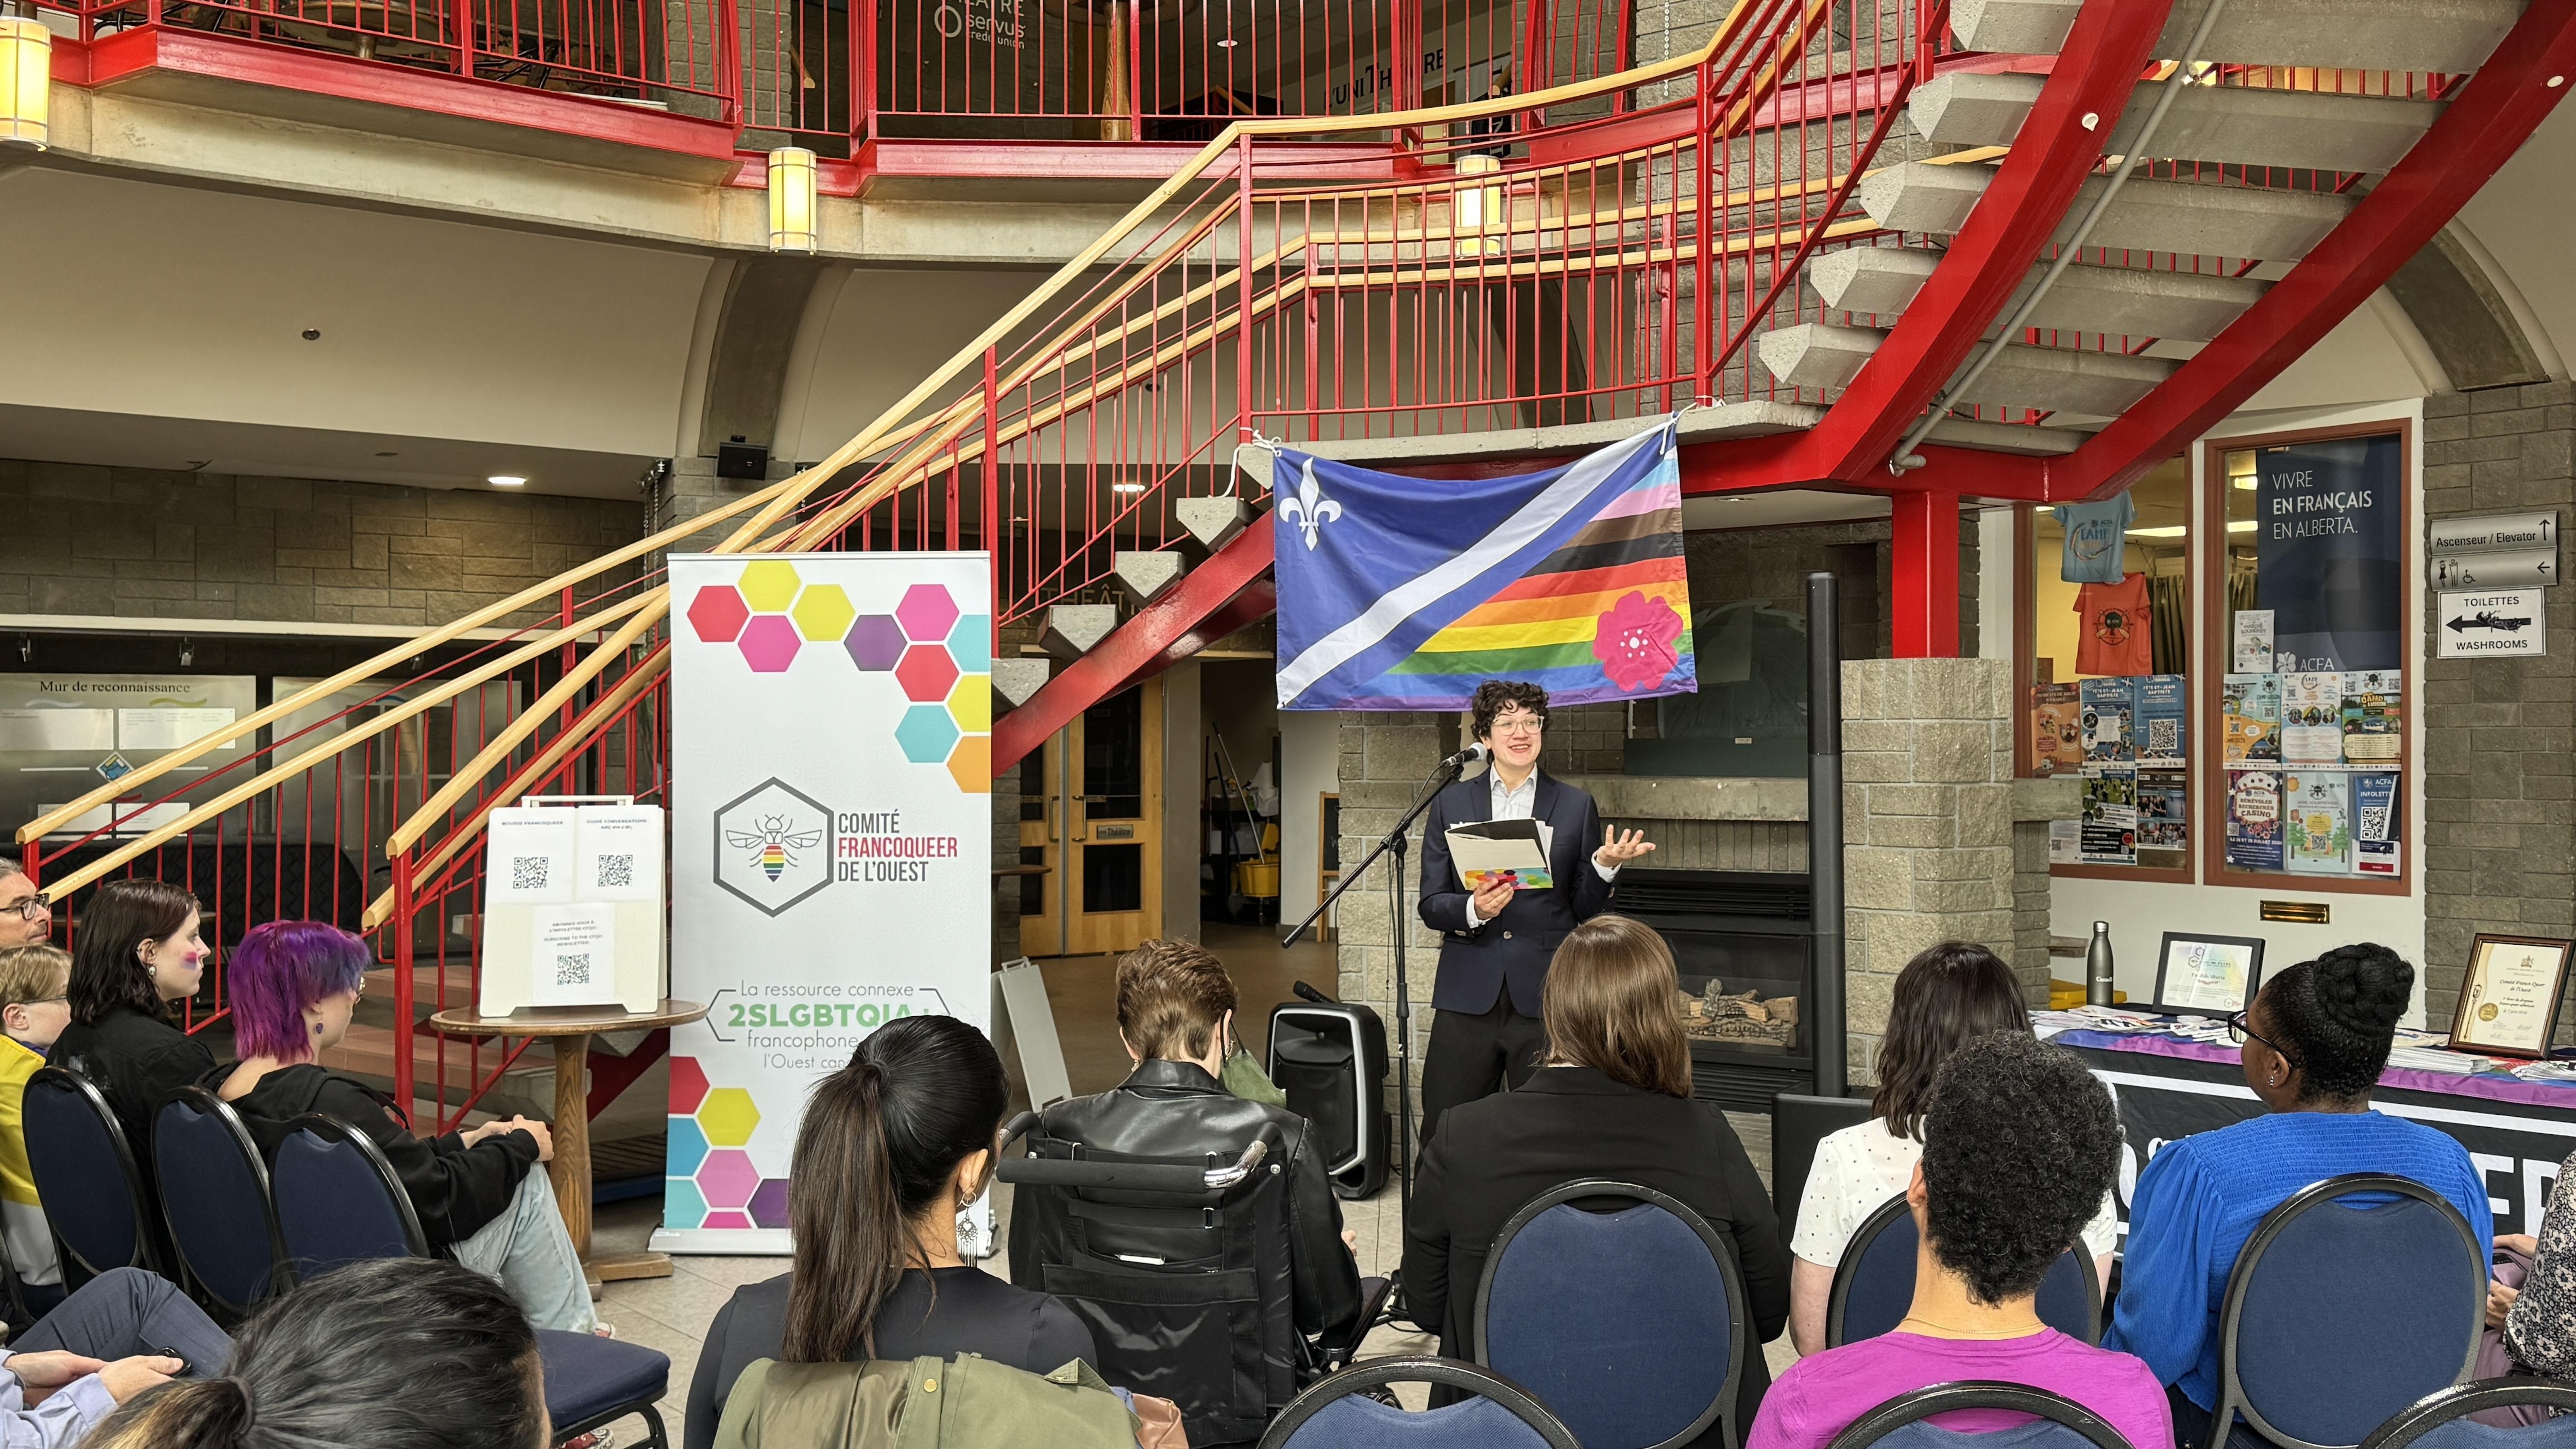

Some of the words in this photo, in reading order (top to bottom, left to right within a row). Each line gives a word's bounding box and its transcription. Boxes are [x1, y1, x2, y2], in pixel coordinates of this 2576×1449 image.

[2272, 470, 2313, 490] VIVRE
[2273, 497, 2293, 515] EN
[2297, 490, 2372, 513] FRANÇAIS
[2274, 522, 2292, 539] EN
[2296, 517, 2358, 537] ALBERTA.
[2436, 535, 2487, 548] Ascenseur
[2489, 533, 2493, 544] /
[2497, 532, 2536, 543] Elevator
[2464, 596, 2519, 607] TOILETTES
[2456, 640, 2528, 650] WASHROOMS
[2300, 657, 2335, 672] ACFA
[40, 680, 68, 692] Mur
[73, 680, 88, 692] de
[92, 681, 191, 693] reconnaissance
[838, 809, 900, 833] COMITÉ
[2241, 810, 2272, 818] CASINO
[838, 837, 957, 859] FRANCOQUEER
[838, 861, 859, 882] DE
[865, 861, 929, 882] L'OUEST
[741, 980, 758, 996] La
[765, 985, 841, 996] ressource
[848, 985, 914, 996] connexe
[728, 1003, 929, 1027] 2SLGBTQIA
[763, 1053, 815, 1069] l'Ouest
